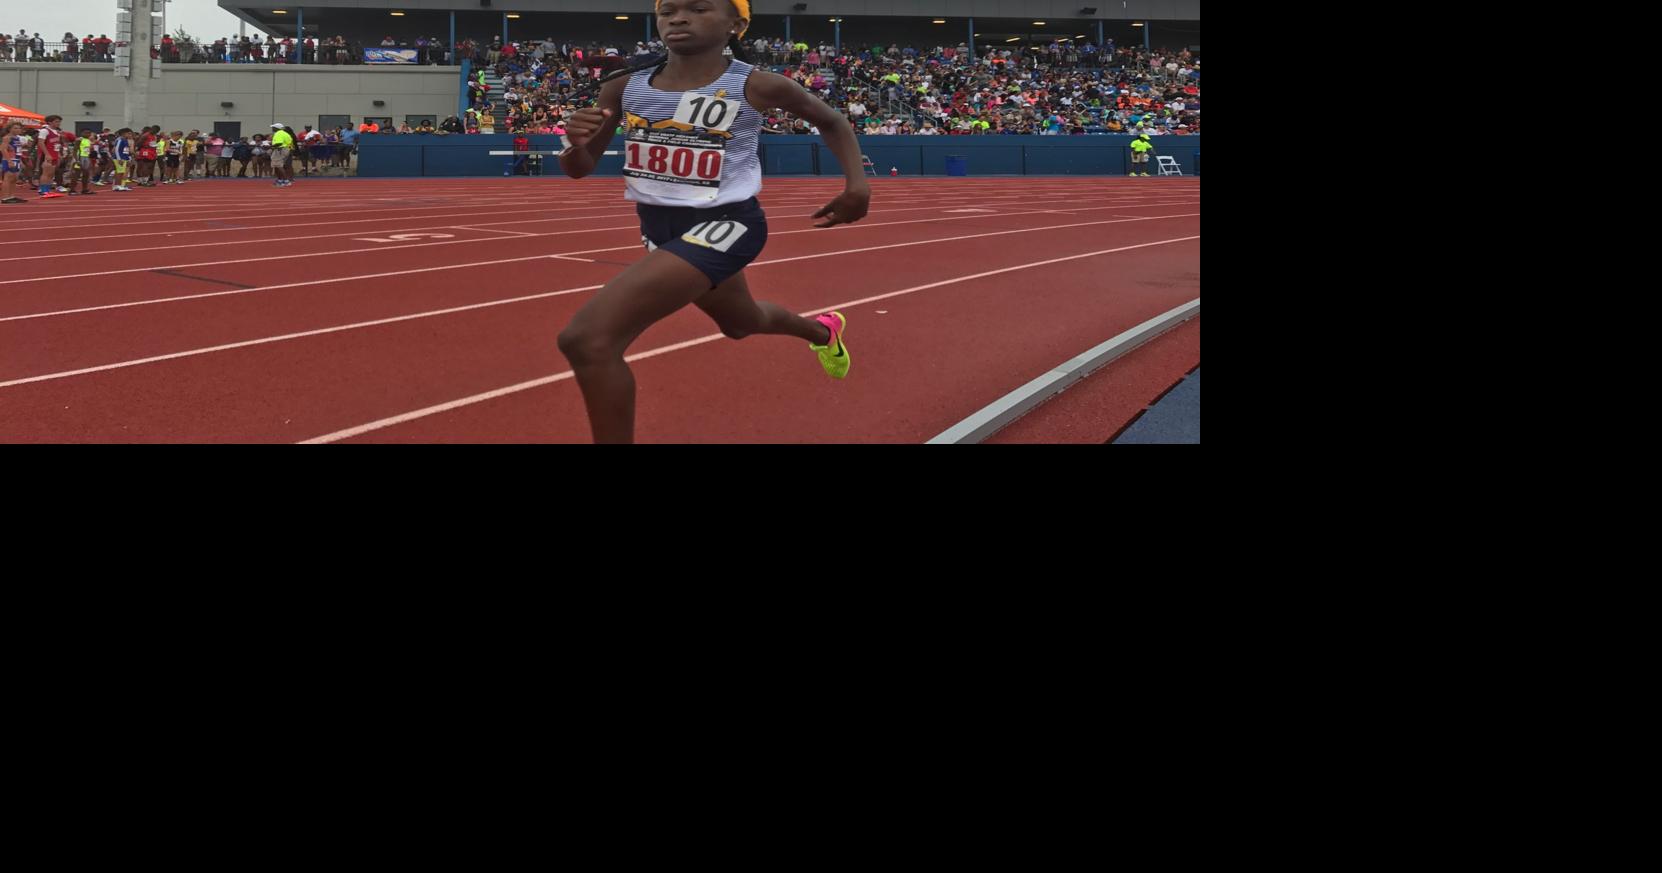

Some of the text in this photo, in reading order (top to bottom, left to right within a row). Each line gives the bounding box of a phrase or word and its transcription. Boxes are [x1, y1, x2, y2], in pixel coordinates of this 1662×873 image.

[689, 96, 727, 128] 10
[627, 143, 722, 179] 1800
[692, 220, 735, 245] 10
